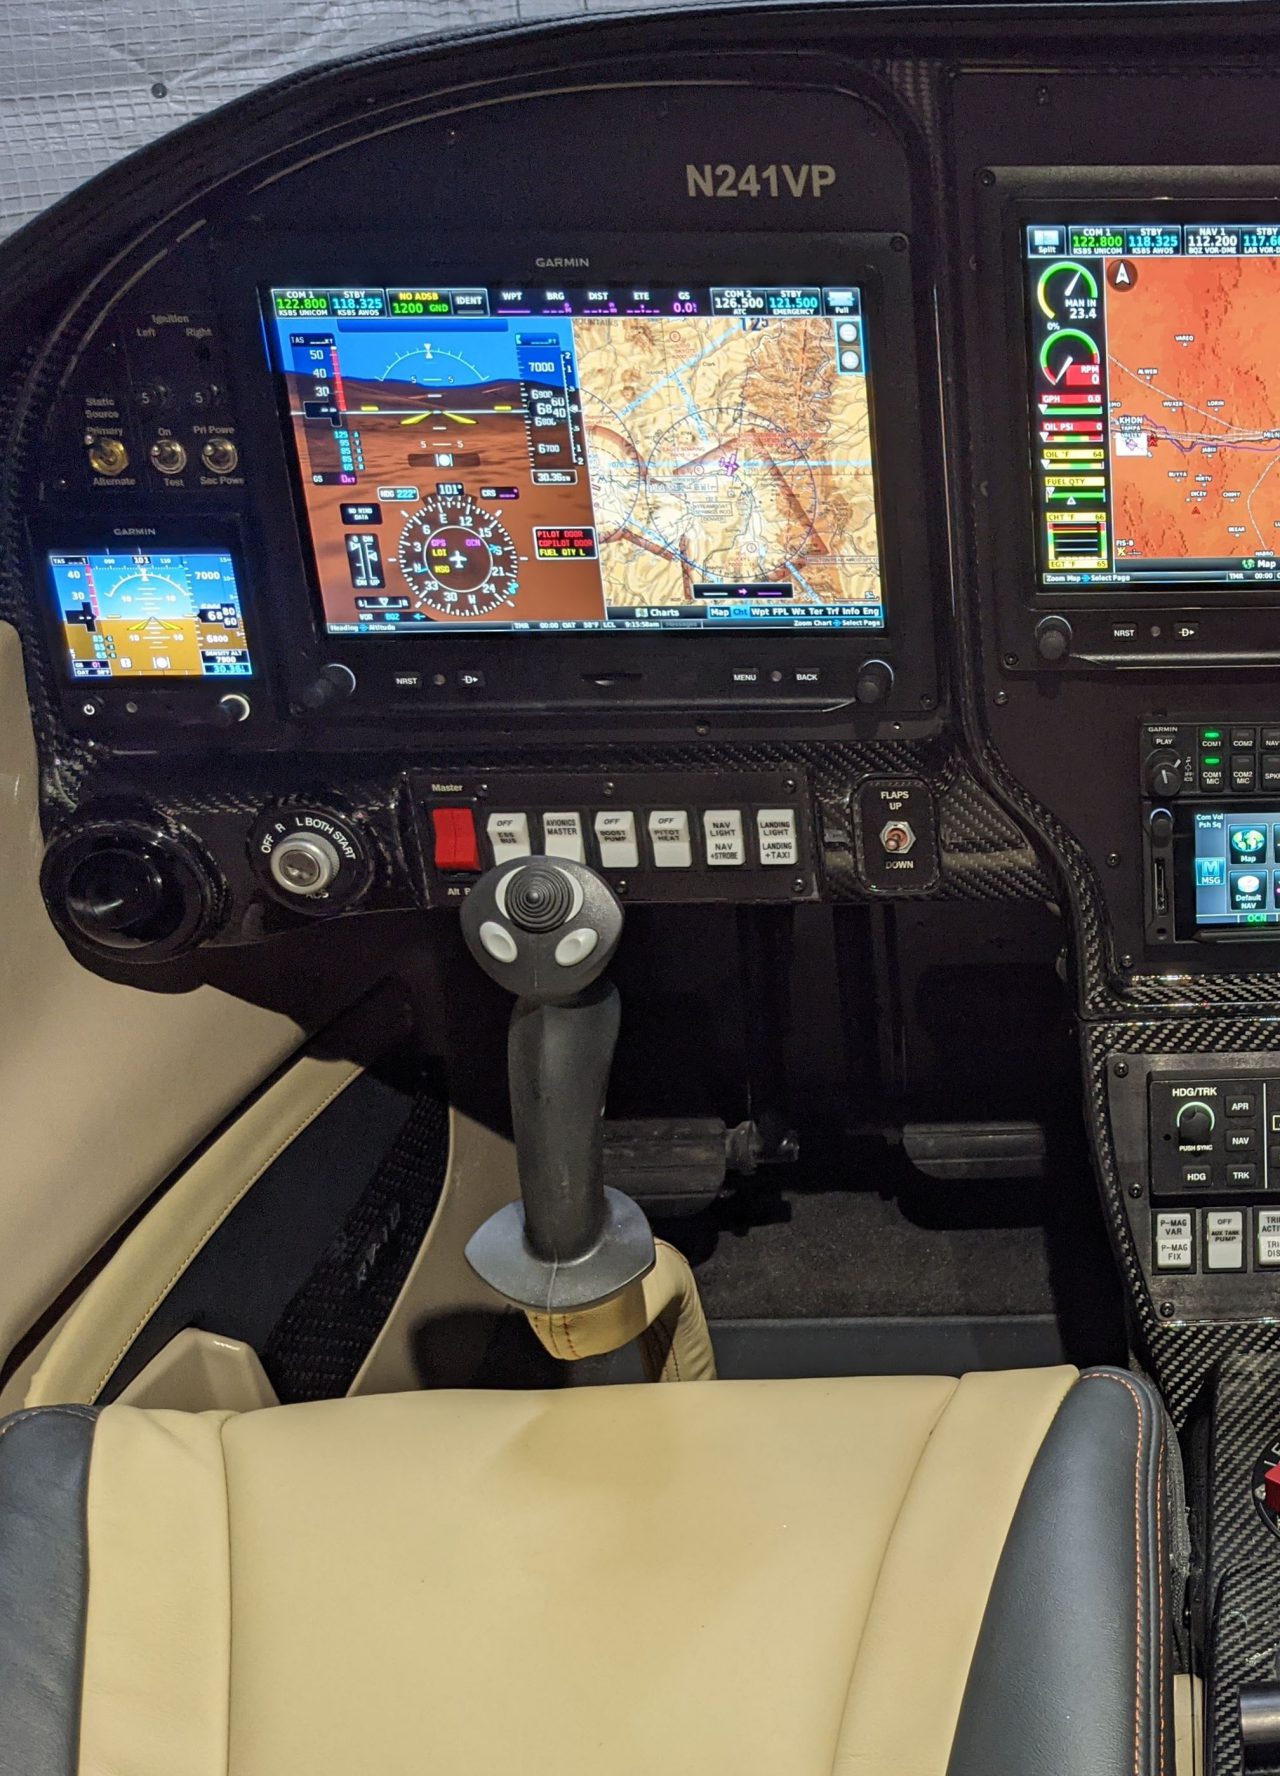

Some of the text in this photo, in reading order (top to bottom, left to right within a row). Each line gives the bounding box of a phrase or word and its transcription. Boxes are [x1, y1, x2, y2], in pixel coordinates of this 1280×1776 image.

[686, 164, 836, 197] N241VP
[1140, 228, 1162, 236] STBY
[1072, 236, 1122, 247] 122.800
[1128, 236, 1178, 247] 118.325
[1188, 236, 1238, 247] 112.200
[535, 258, 589, 268] GARMIN
[277, 299, 327, 309] 122.800
[332, 299, 382, 309] 118.325
[715, 298, 763, 309] 126.500
[769, 297, 818, 308] 121.500
[393, 303, 423, 314] 1200
[1070, 308, 1097, 320] 23.4
[136, 328, 156, 337] Left
[528, 362, 555, 372] 7000
[1080, 365, 1099, 374] RPM
[1042, 395, 1060, 403] GPH
[85, 410, 119, 418] Source
[86, 427, 123, 436] Primary
[93, 477, 136, 486] Alternate
[164, 478, 184, 487] Test
[1047, 478, 1066, 486] FUEL
[538, 530, 560, 538] PILOT
[1258, 560, 1276, 569] Map
[195, 571, 220, 580] 7000
[650, 608, 679, 618] Charts
[711, 608, 729, 618] Map
[773, 608, 789, 616] FPL
[842, 607, 860, 616] Info
[431, 784, 462, 792] Master
[881, 791, 909, 800] FLAPS
[889, 802, 902, 810] UP
[710, 829, 736, 837] LIGHT
[763, 828, 789, 836] LIGHT
[261, 823, 286, 854] OFF R
[305, 817, 356, 860] BOTH START
[1240, 855, 1256, 863] Map
[886, 861, 914, 869] DOWN
[1172, 1087, 1217, 1097] HDG/TRK
[1232, 1137, 1249, 1145] NAV
[1187, 1173, 1206, 1181] HDG
[1160, 1219, 1187, 1227] P-MAG
